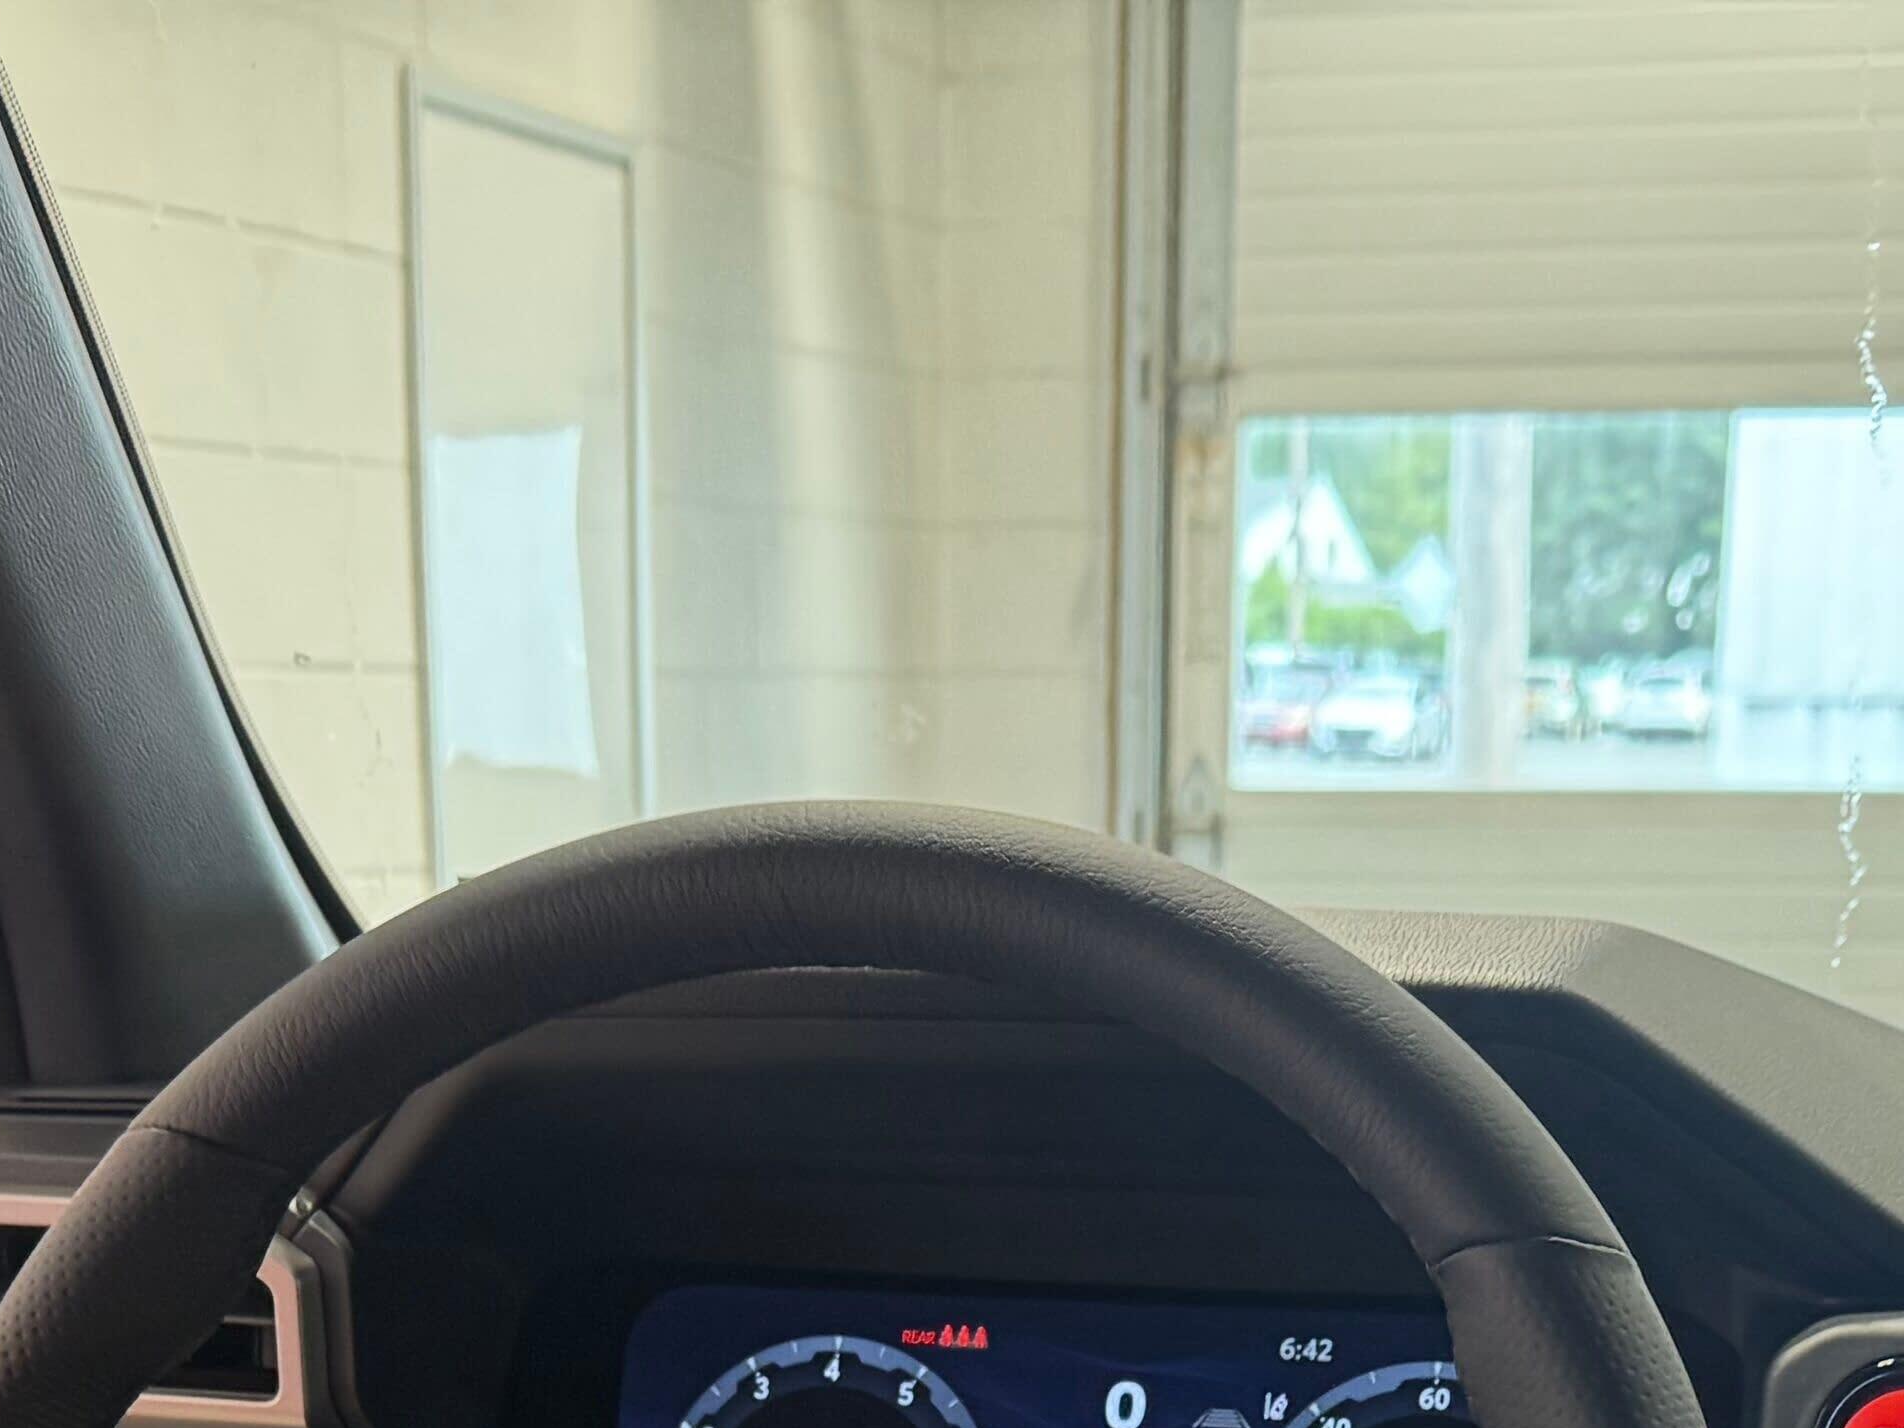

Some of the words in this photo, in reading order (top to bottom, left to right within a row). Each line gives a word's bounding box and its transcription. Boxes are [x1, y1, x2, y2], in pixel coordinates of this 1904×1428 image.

[1279, 1338, 1333, 1362] 6:42
[823, 1357, 840, 1382] 4
[753, 1376, 770, 1400] 3
[897, 1380, 915, 1406] 5
[1418, 1387, 1451, 1412] 60
